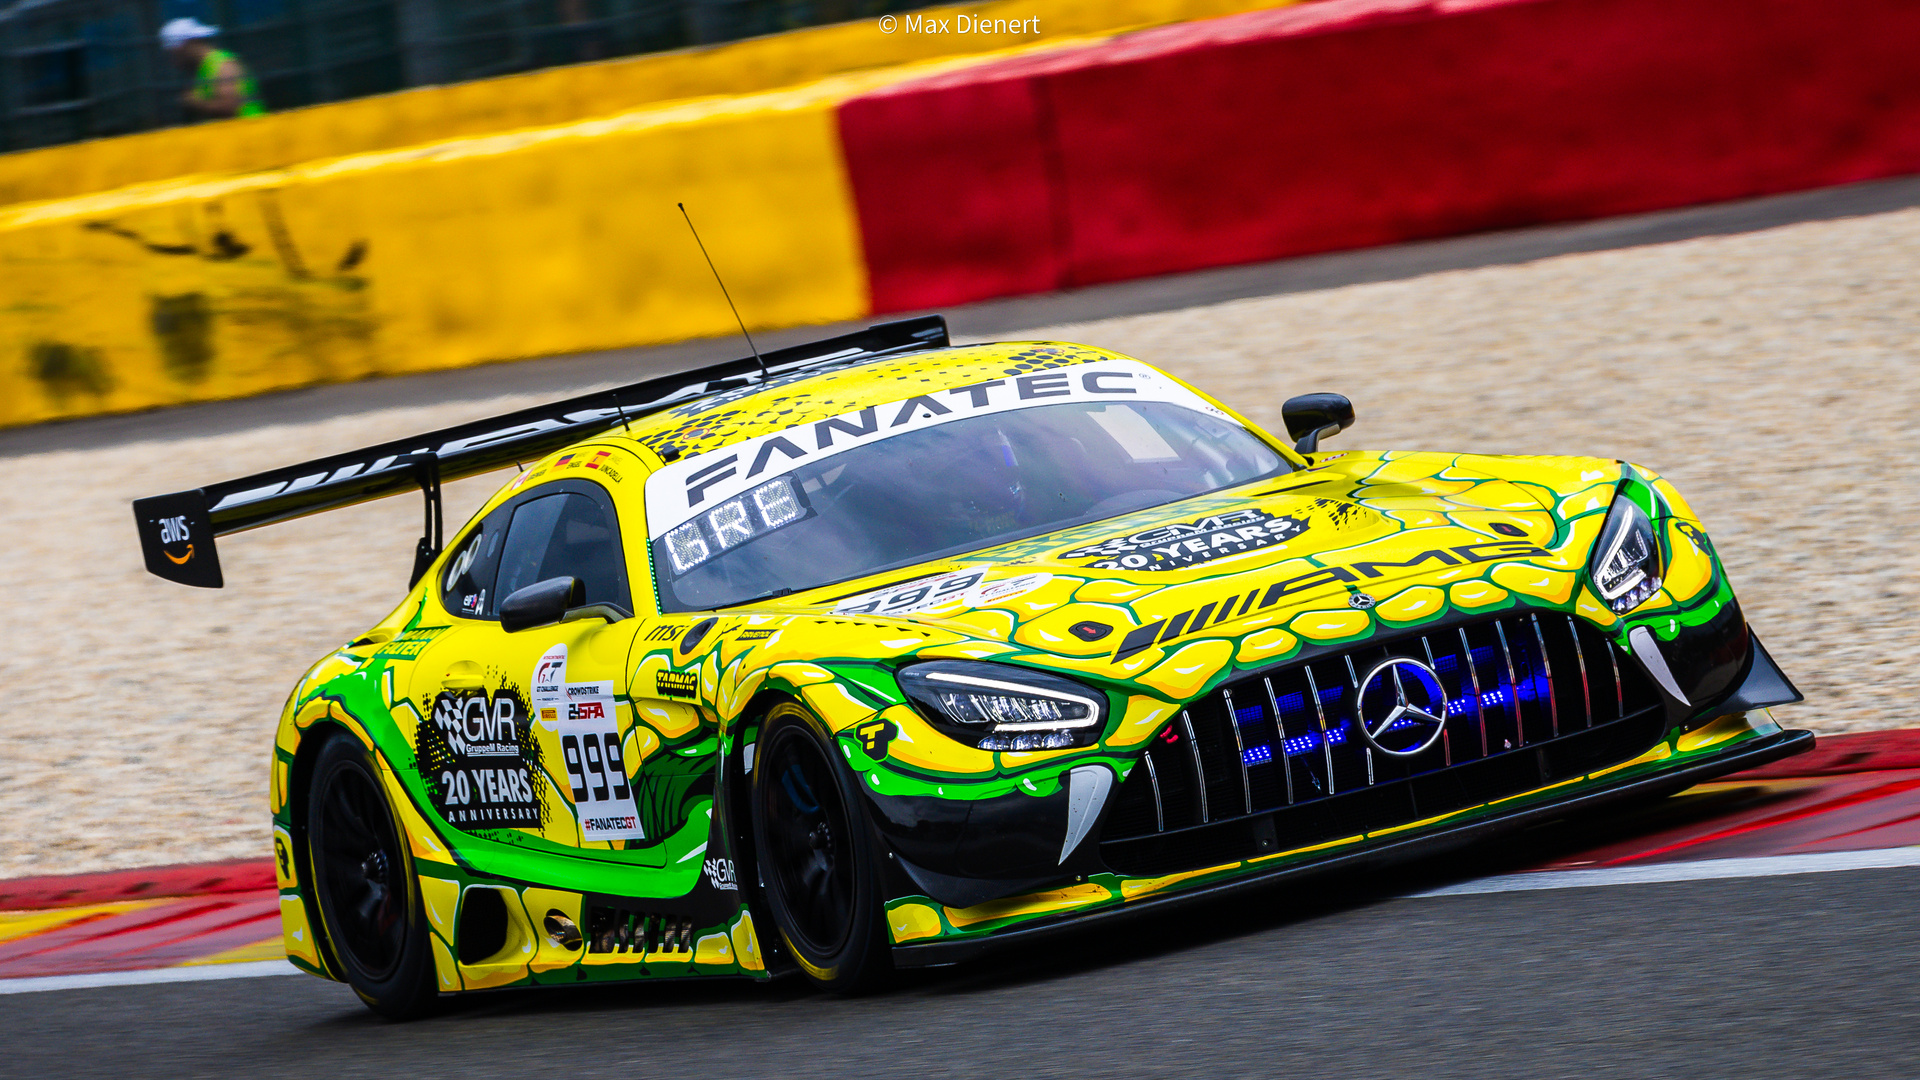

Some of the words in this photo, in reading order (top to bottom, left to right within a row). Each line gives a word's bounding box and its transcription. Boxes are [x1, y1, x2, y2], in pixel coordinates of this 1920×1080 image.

[684, 372, 1137, 508] FANATEC
[158, 515, 190, 544] aws
[1151, 517, 1292, 558] YEARS
[643, 625, 689, 641] msi
[567, 686, 600, 696] CROWDSTRIKE
[466, 743, 496, 754] GruppeM
[496, 743, 520, 755] Racing
[562, 732, 631, 803] 999
[441, 769, 470, 806] 20
[471, 768, 533, 804] YEARS
[448, 808, 539, 823] ANNIVERSARY
[584, 816, 637, 831] #FANATECGT
